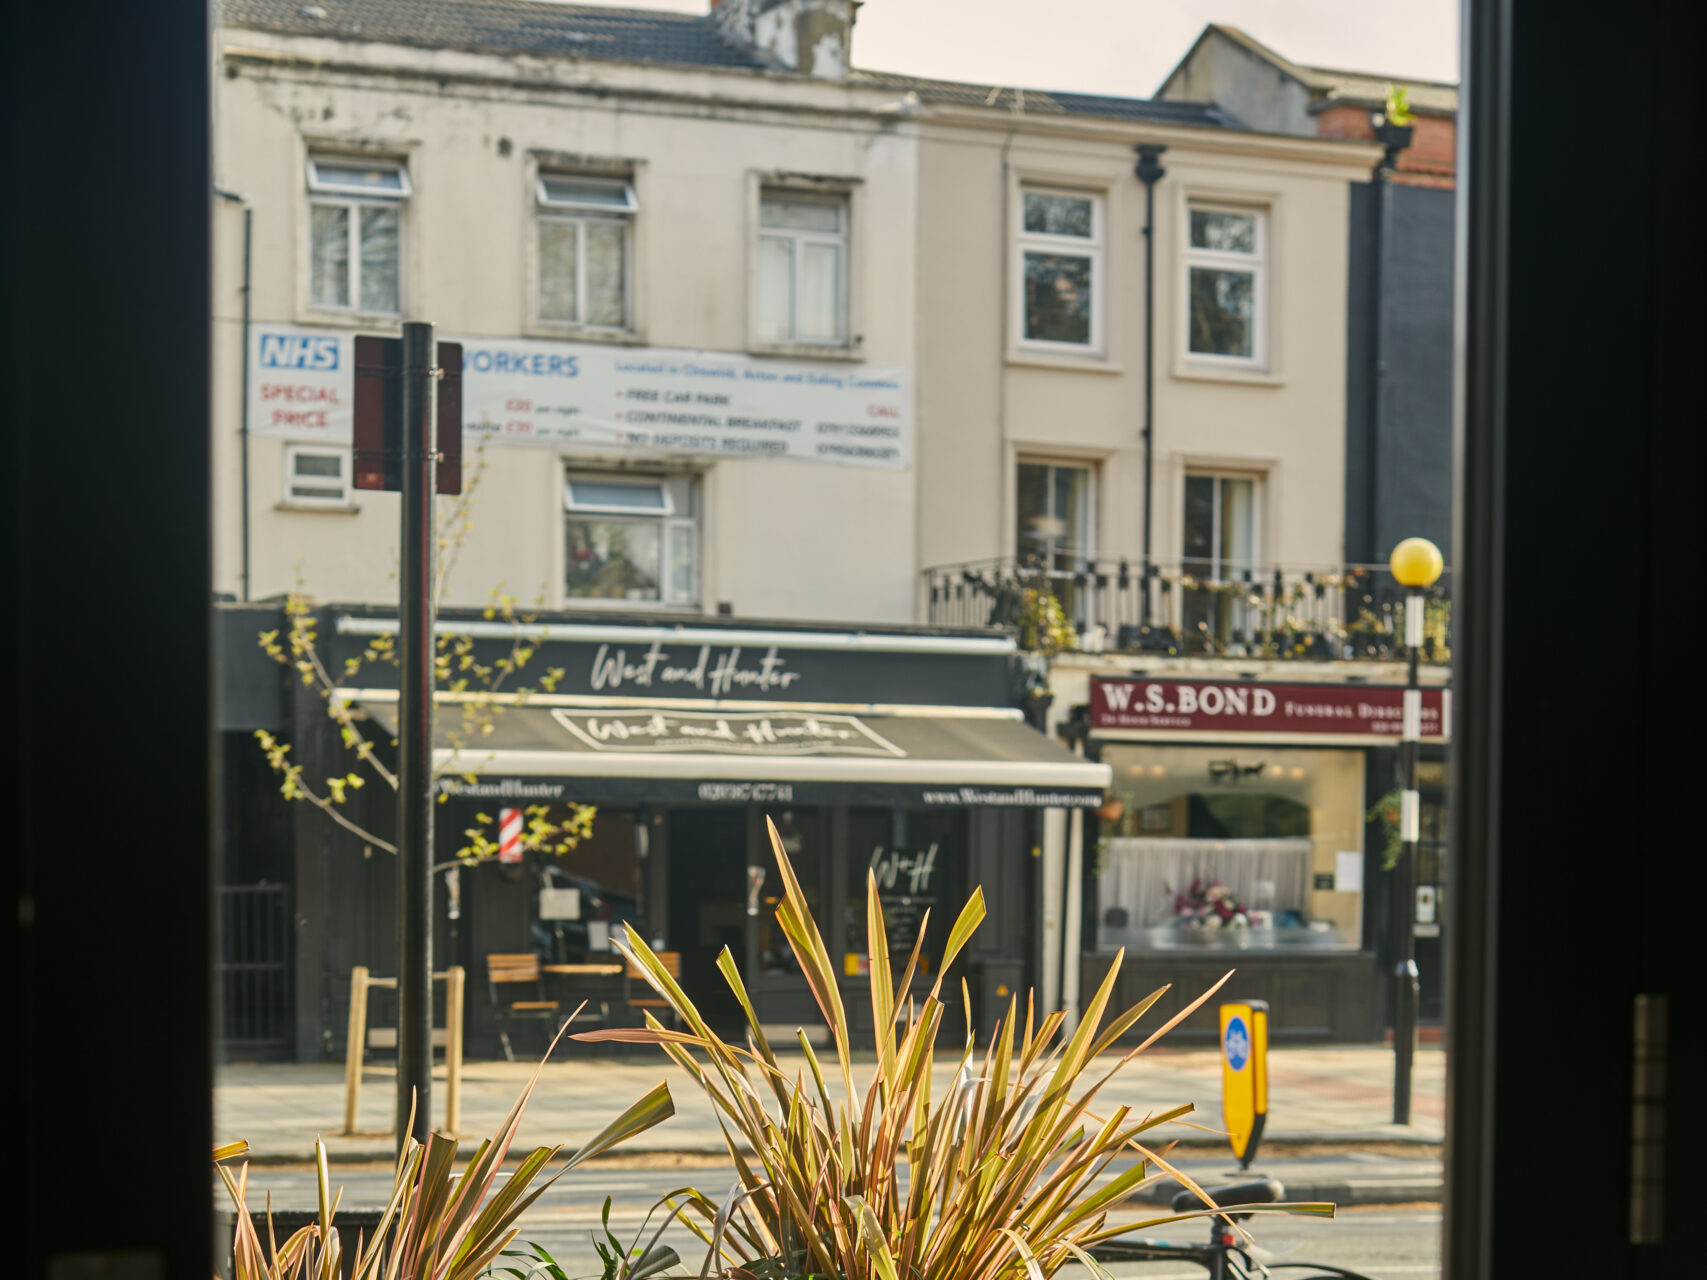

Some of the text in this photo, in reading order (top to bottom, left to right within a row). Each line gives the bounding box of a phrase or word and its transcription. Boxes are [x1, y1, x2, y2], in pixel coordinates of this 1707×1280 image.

[263, 338, 336, 367] NHS
[260, 384, 341, 405] SPECIAL
[626, 388, 730, 406] FREE CAR PARK
[271, 408, 328, 428] PRICE
[626, 410, 721, 427] CONTINENTAL
[726, 416, 801, 431] BREAKFAST
[866, 404, 900, 418] CALL
[722, 437, 788, 454] REQUIRED
[590, 642, 801, 697] West and Hunter
[1284, 701, 1354, 718] FUNERAL
[1358, 703, 1439, 720] DIRECRS
[587, 713, 676, 740] West
[680, 719, 737, 739] and
[742, 719, 856, 744] Hunter
